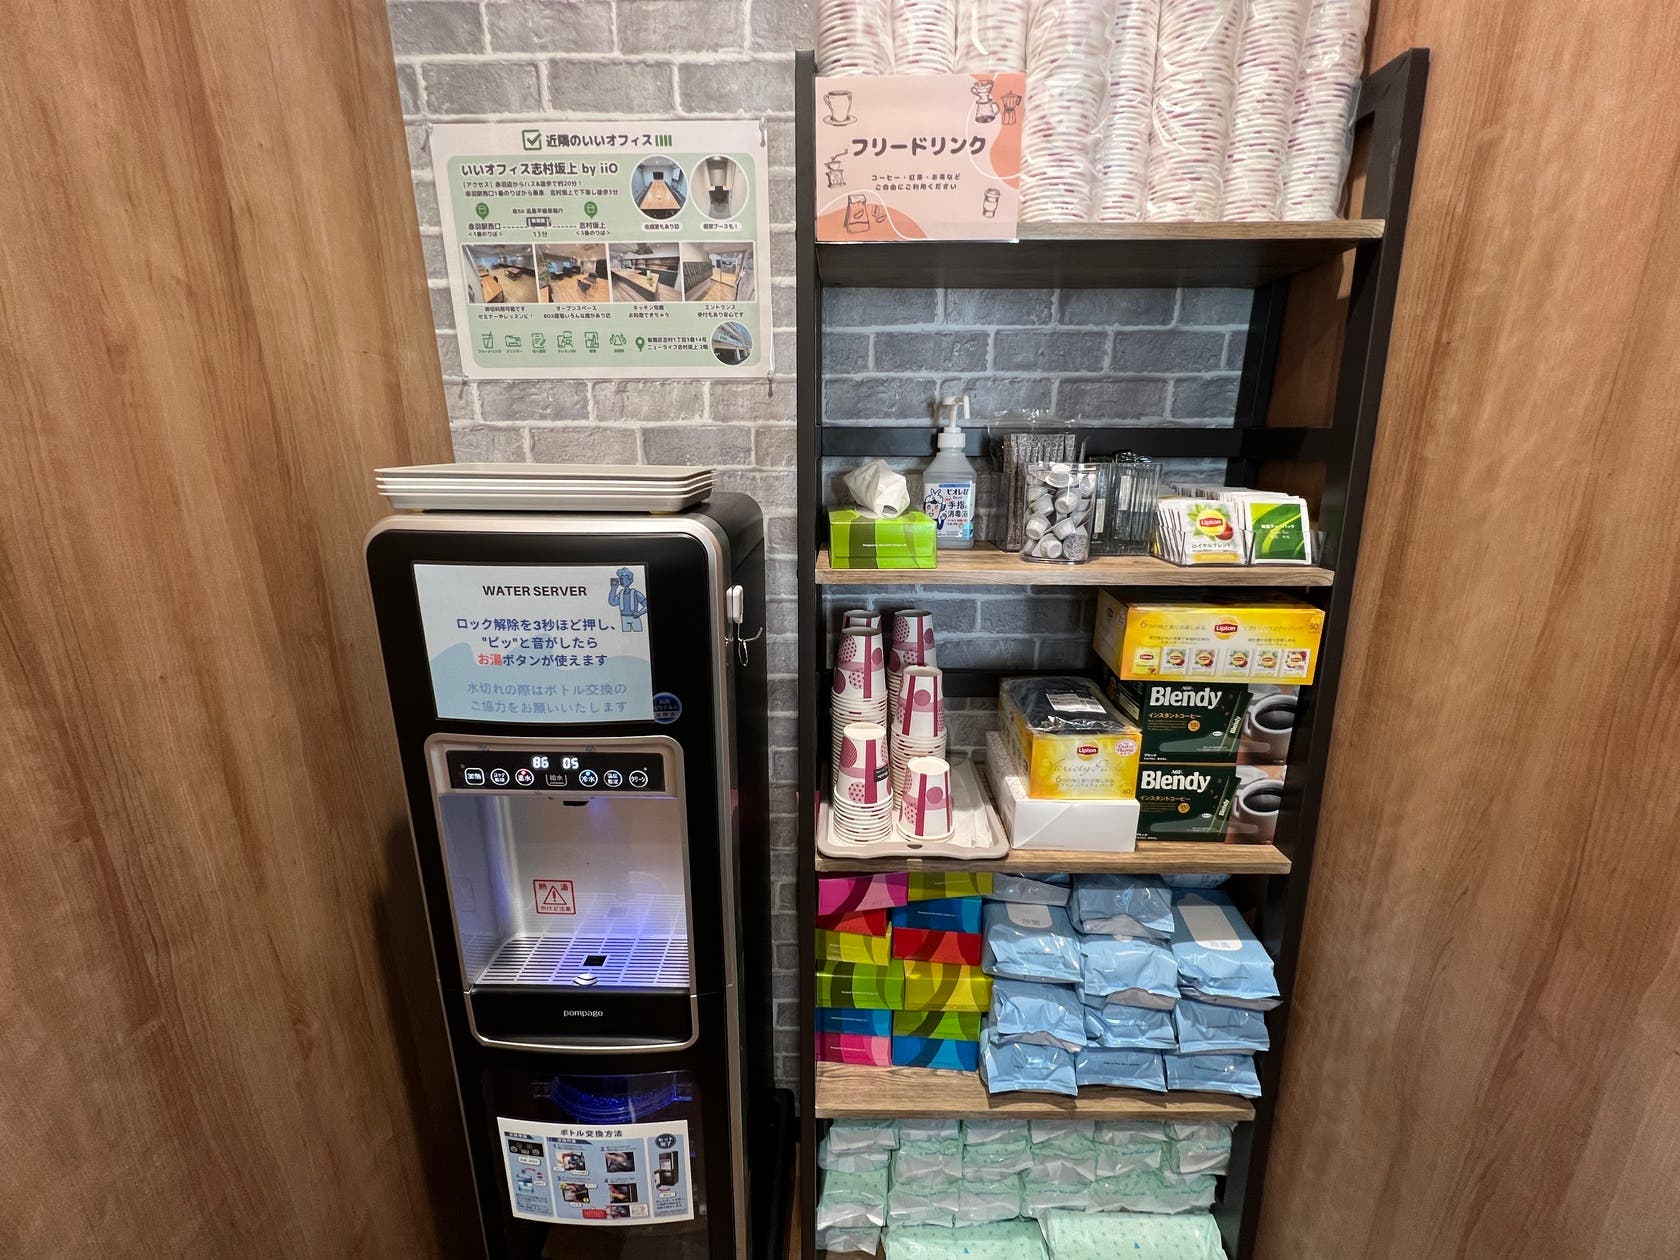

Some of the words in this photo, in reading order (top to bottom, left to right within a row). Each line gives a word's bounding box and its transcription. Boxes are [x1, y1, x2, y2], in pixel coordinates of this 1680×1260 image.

[546, 134, 653, 148] 近隣のいいオフィス
[852, 135, 986, 156] フリードリンク
[461, 162, 578, 176] いいオフィス志村坂上
[582, 162, 596, 176] by
[600, 162, 618, 174] iiO
[871, 173, 961, 181] コーヒー・紅茶・お茶など
[875, 183, 957, 191] ご自由にご利用ください
[1201, 519, 1222, 527] Lipton
[482, 585, 530, 597] WATER
[533, 585, 587, 597] SERVER
[1215, 624, 1236, 633] Lipton
[477, 653, 608, 667] お湯ボタンが使えます
[466, 682, 628, 697] 水切れの際はボトル交換の
[1149, 687, 1223, 709] Blendy
[470, 700, 628, 715] ご協力をお願いいたします
[1229, 715, 1242, 734] Blendy
[1078, 747, 1097, 755] Lipton
[532, 756, 549, 769] 86
[630, 774, 646, 783] クリーン
[1141, 770, 1211, 793] Blendy
[1218, 798, 1230, 817] Blendy
[563, 1009, 603, 1017] pompago
[560, 1129, 623, 1138] ボトル交換方法
